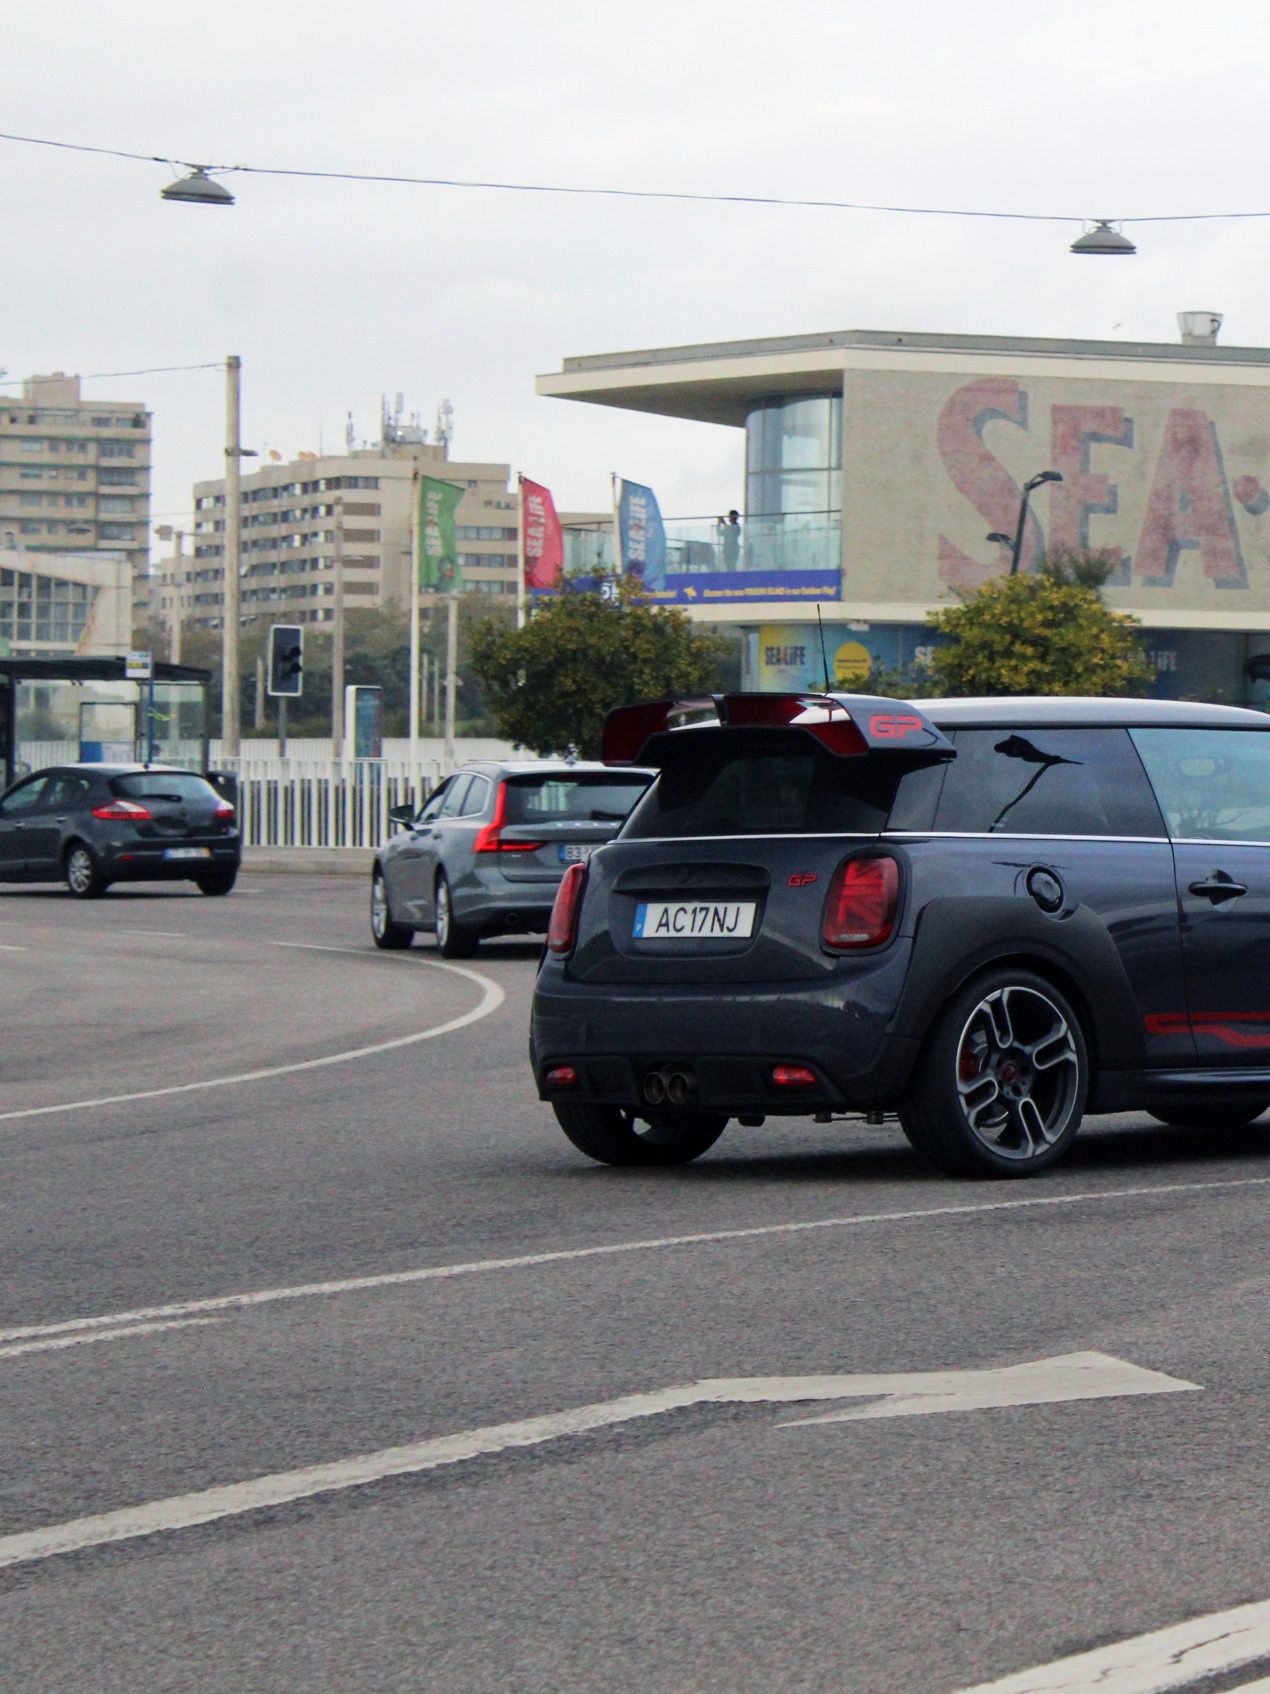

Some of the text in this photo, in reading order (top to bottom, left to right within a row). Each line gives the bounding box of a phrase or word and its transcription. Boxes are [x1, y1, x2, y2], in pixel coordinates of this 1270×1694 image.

[937, 378, 1249, 594] SEA
[526, 526, 545, 558] SEA
[628, 530, 646, 560] SEA
[869, 715, 923, 738] GP
[787, 874, 817, 886] GP
[655, 906, 740, 933] AC17NJ
